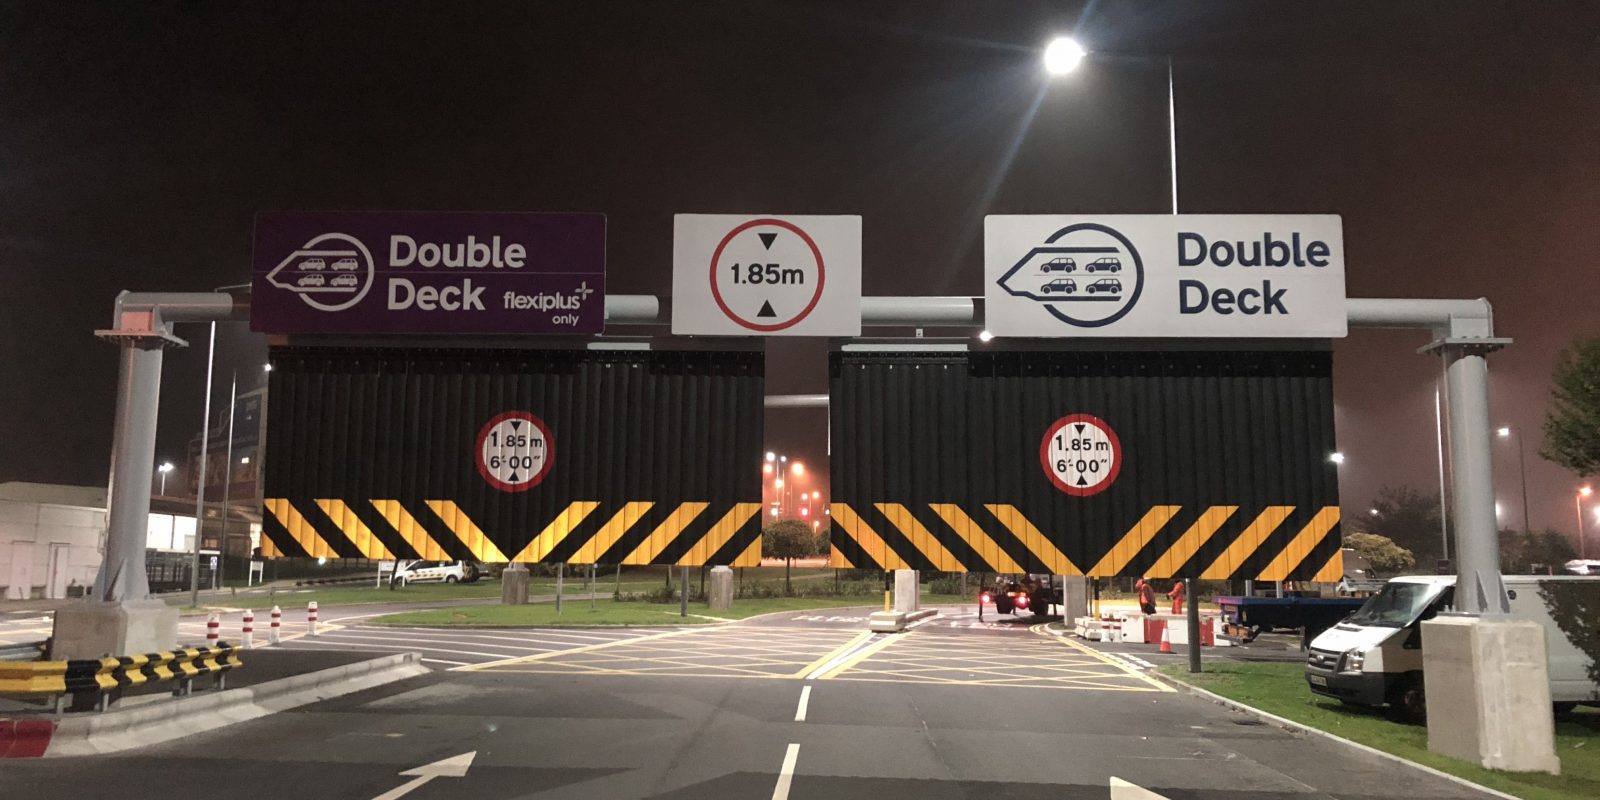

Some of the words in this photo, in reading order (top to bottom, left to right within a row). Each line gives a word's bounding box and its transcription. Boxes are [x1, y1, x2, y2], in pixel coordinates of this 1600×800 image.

[389, 235, 527, 268] Double
[1177, 232, 1330, 267] Double
[731, 263, 804, 284] 1.85m
[387, 278, 486, 311] Deck
[1179, 279, 1288, 315] Deck
[552, 314, 579, 326] only
